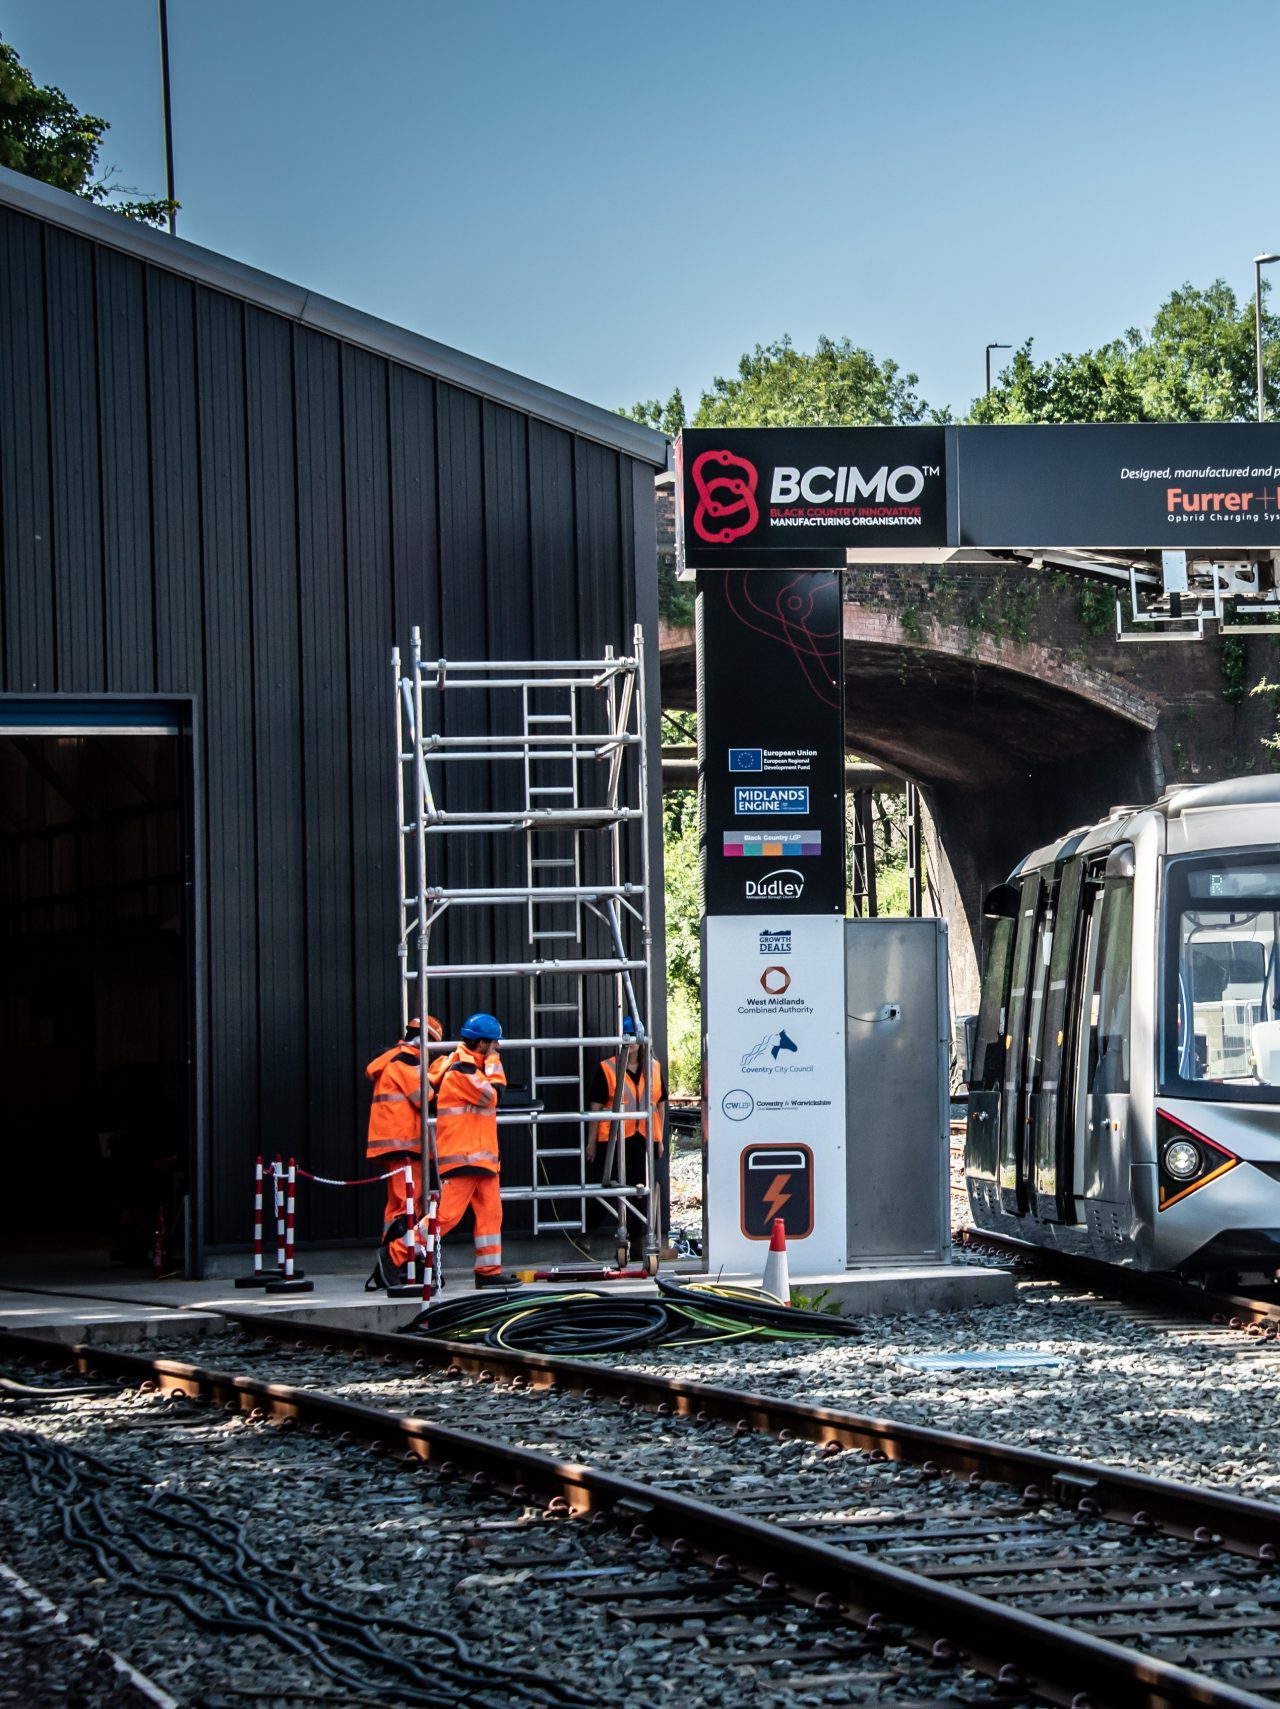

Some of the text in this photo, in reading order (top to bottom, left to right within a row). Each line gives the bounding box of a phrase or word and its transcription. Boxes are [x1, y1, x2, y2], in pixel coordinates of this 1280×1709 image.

[1120, 468, 1172, 481] Designed,
[1174, 466, 1249, 478] manufactured
[1251, 466, 1272, 477] and
[770, 465, 925, 504] BCIMO
[770, 507, 921, 517] BLACK COUNTRY INNOVATIVE
[770, 516, 922, 527] MANUFACTURING ORGANISATION
[1167, 514, 1205, 523] Opbrid
[1210, 513, 1259, 523] Charging
[738, 790, 805, 801] MIDLANDS
[738, 801, 780, 811] ENGINE
[745, 881, 804, 899] Dudley
[759, 943, 792, 952] DEALS
[746, 998, 767, 1006] West
[737, 1005, 814, 1014] Combined Authority
[741, 1065, 814, 1075] Coventry City Council
[756, 1100, 784, 1108] Coventry
